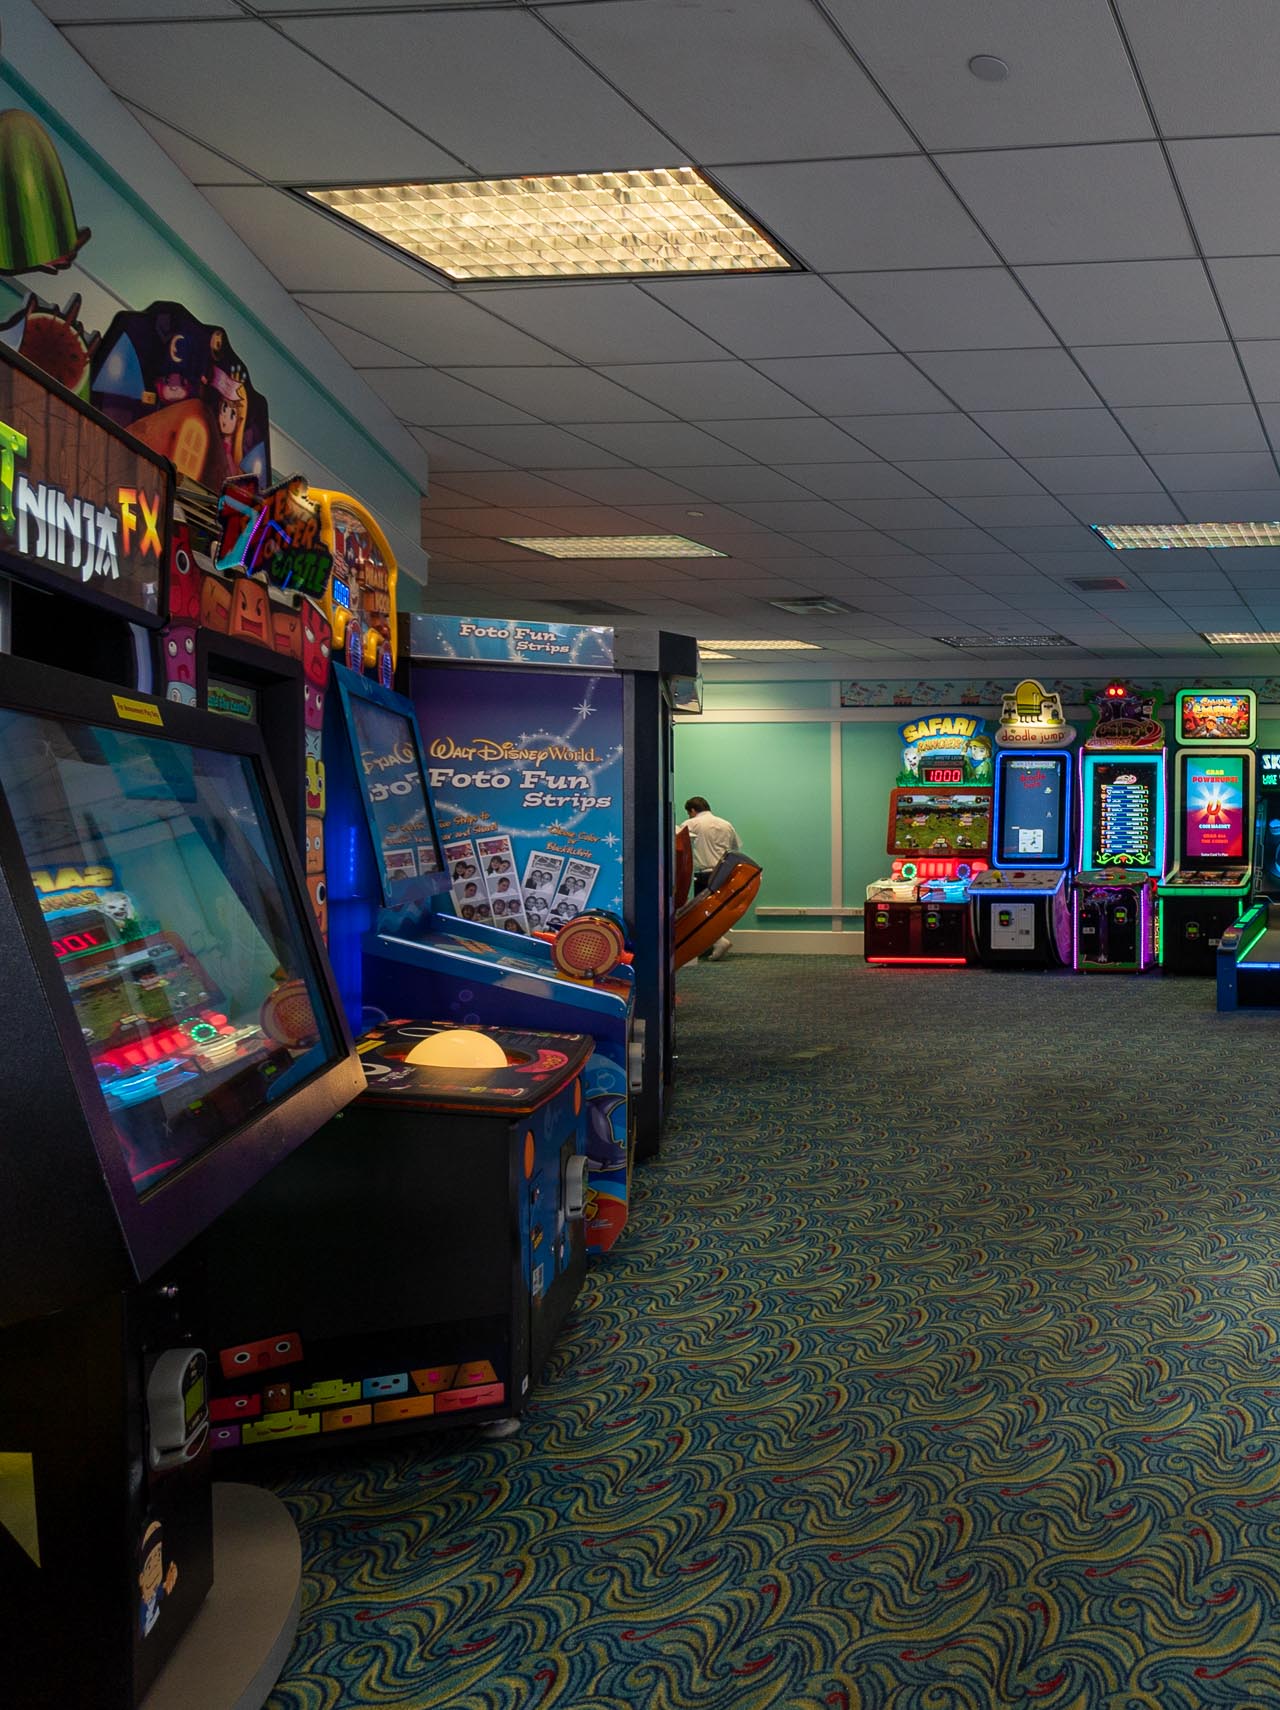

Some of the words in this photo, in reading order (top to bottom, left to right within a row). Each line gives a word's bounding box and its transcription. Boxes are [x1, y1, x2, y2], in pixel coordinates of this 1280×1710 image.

[18, 473, 120, 583] NINJA
[118, 487, 163, 559] FX
[459, 623, 510, 639] Foto
[514, 627, 557, 641] Fun
[516, 641, 570, 655] Strips
[902, 717, 977, 743] SAFARI
[1001, 729, 1037, 741] doodle
[1039, 731, 1065, 744] jump
[548, 746, 596, 762] World
[428, 768, 511, 789] Foto
[519, 770, 589, 790] Fun
[930, 770, 961, 782] 1000
[522, 792, 612, 812] Strips
